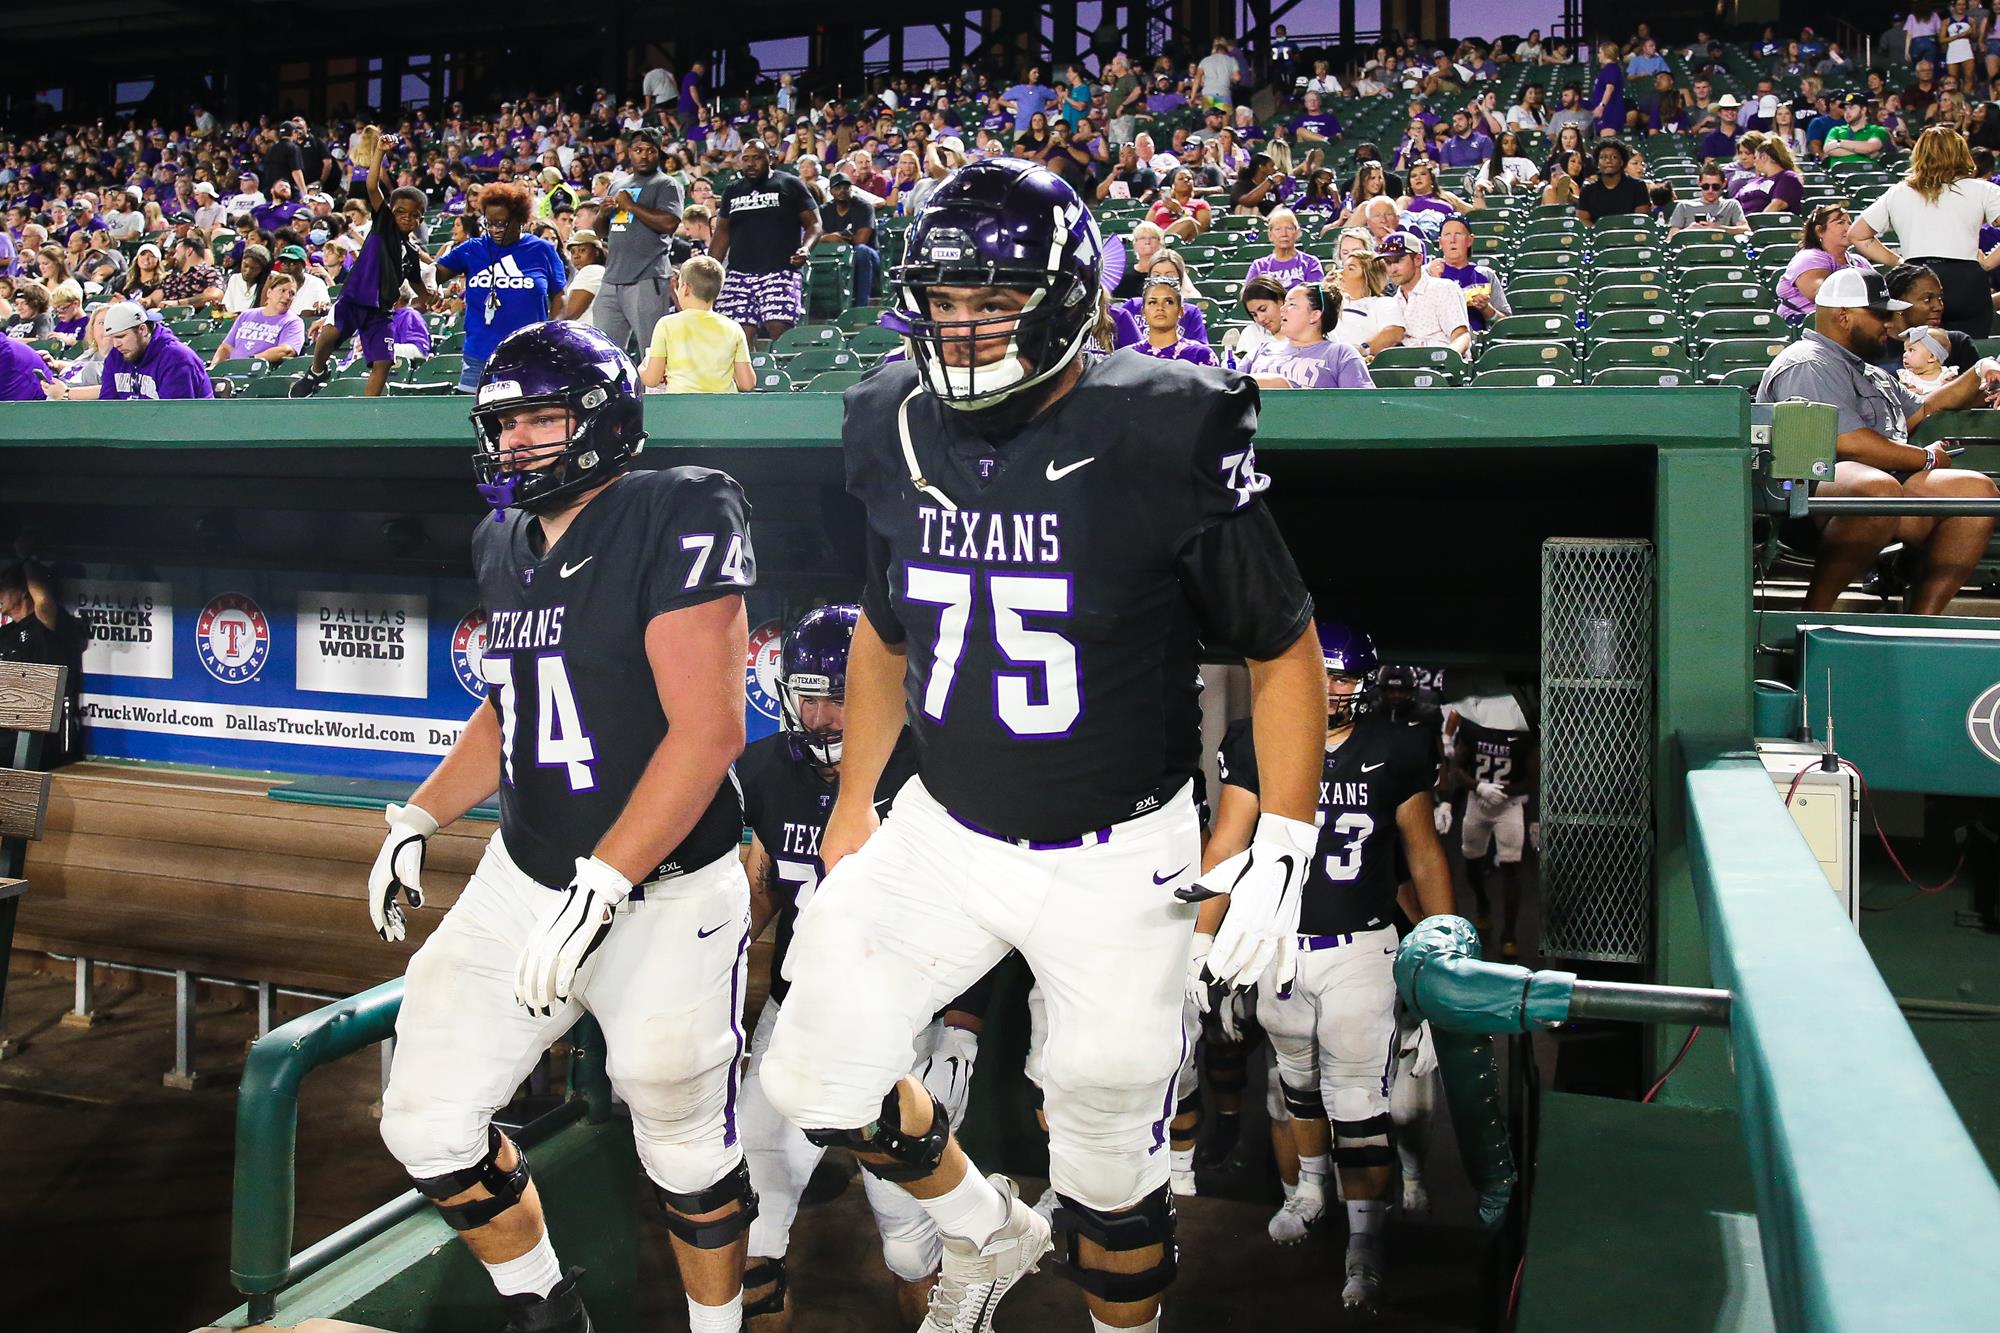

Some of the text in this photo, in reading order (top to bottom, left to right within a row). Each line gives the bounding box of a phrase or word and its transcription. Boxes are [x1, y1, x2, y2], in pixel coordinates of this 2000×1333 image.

[730, 192, 779, 205] TARLETON
[979, 459, 994, 477] T
[918, 506, 1060, 563] TEXANS
[679, 533, 750, 592] 74
[523, 568, 535, 586] T
[78, 592, 154, 611] DALLAS
[320, 606, 406, 625] DALLAS
[320, 623, 404, 643] TRUCK
[489, 606, 566, 649] TEXANS
[219, 620, 246, 658] T
[202, 641, 264, 679] RANGERS
[319, 640, 404, 660] WORLD
[905, 562, 1084, 740] 75
[797, 676, 821, 685] TEXANS
[226, 714, 415, 743] DallasTruckWorld.com
[481, 655, 598, 792] 74
[1478, 742, 1510, 756] TEXANS
[1475, 754, 1512, 785] 22
[1136, 796, 1159, 812] 2XL
[1318, 783, 1369, 806] XANS
[783, 823, 821, 856] TEX
[659, 861, 682, 874] 2XL
